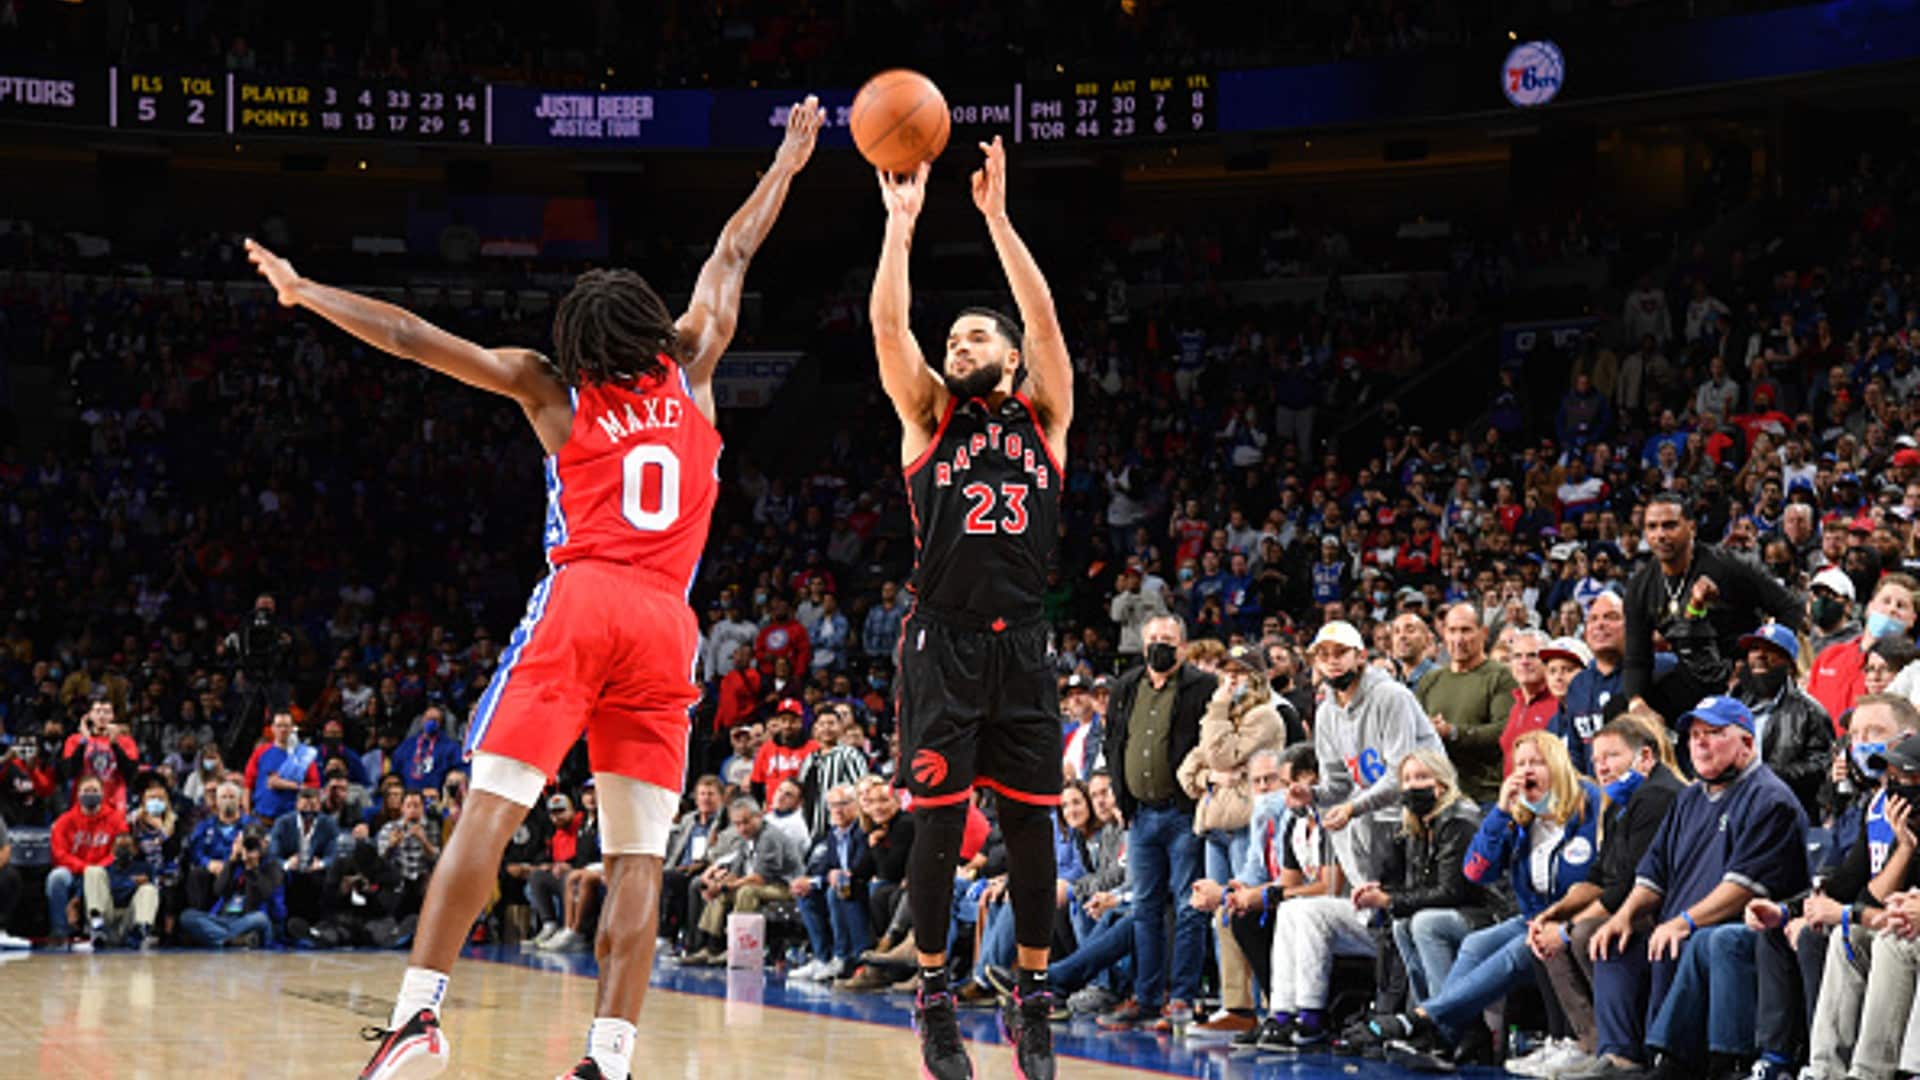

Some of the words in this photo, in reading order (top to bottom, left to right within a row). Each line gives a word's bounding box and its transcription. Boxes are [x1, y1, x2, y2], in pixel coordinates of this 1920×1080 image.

[131, 74, 163, 93] FLS
[180, 77, 215, 96] TOL
[240, 83, 310, 105] PLAYER
[325, 87, 338, 106] 3
[358, 89, 373, 107] 4
[387, 90, 411, 109] 33
[420, 92, 444, 112] 23
[456, 92, 477, 112] 14
[137, 96, 157, 121] 5
[186, 98, 206, 124] 2
[535, 93, 595, 119] JUSTIN
[597, 94, 654, 120] BIEBER
[981, 104, 1012, 125] PM
[1030, 100, 1064, 121] PHI
[1075, 98, 1098, 116] 37
[1111, 96, 1136, 115] 30
[1154, 94, 1166, 113] 7
[1191, 90, 1205, 110] 8
[241, 108, 309, 128] POINTS
[322, 112, 342, 131] 18
[356, 113, 376, 131] 13
[389, 114, 408, 132] 17
[419, 115, 444, 134] 29
[458, 117, 470, 136] 5
[549, 119, 603, 138] JUSTICE
[607, 120, 641, 137] TOUR
[1030, 121, 1065, 140] TOR
[1075, 119, 1099, 137] 44
[1111, 117, 1136, 136] 23
[1153, 115, 1168, 135] 6
[1191, 111, 1206, 131] 9
[936, 422, 1048, 490] RAPTORS
[621, 443, 681, 532] 0
[962, 481, 1029, 535] 23
[1344, 746, 1387, 791] 76
